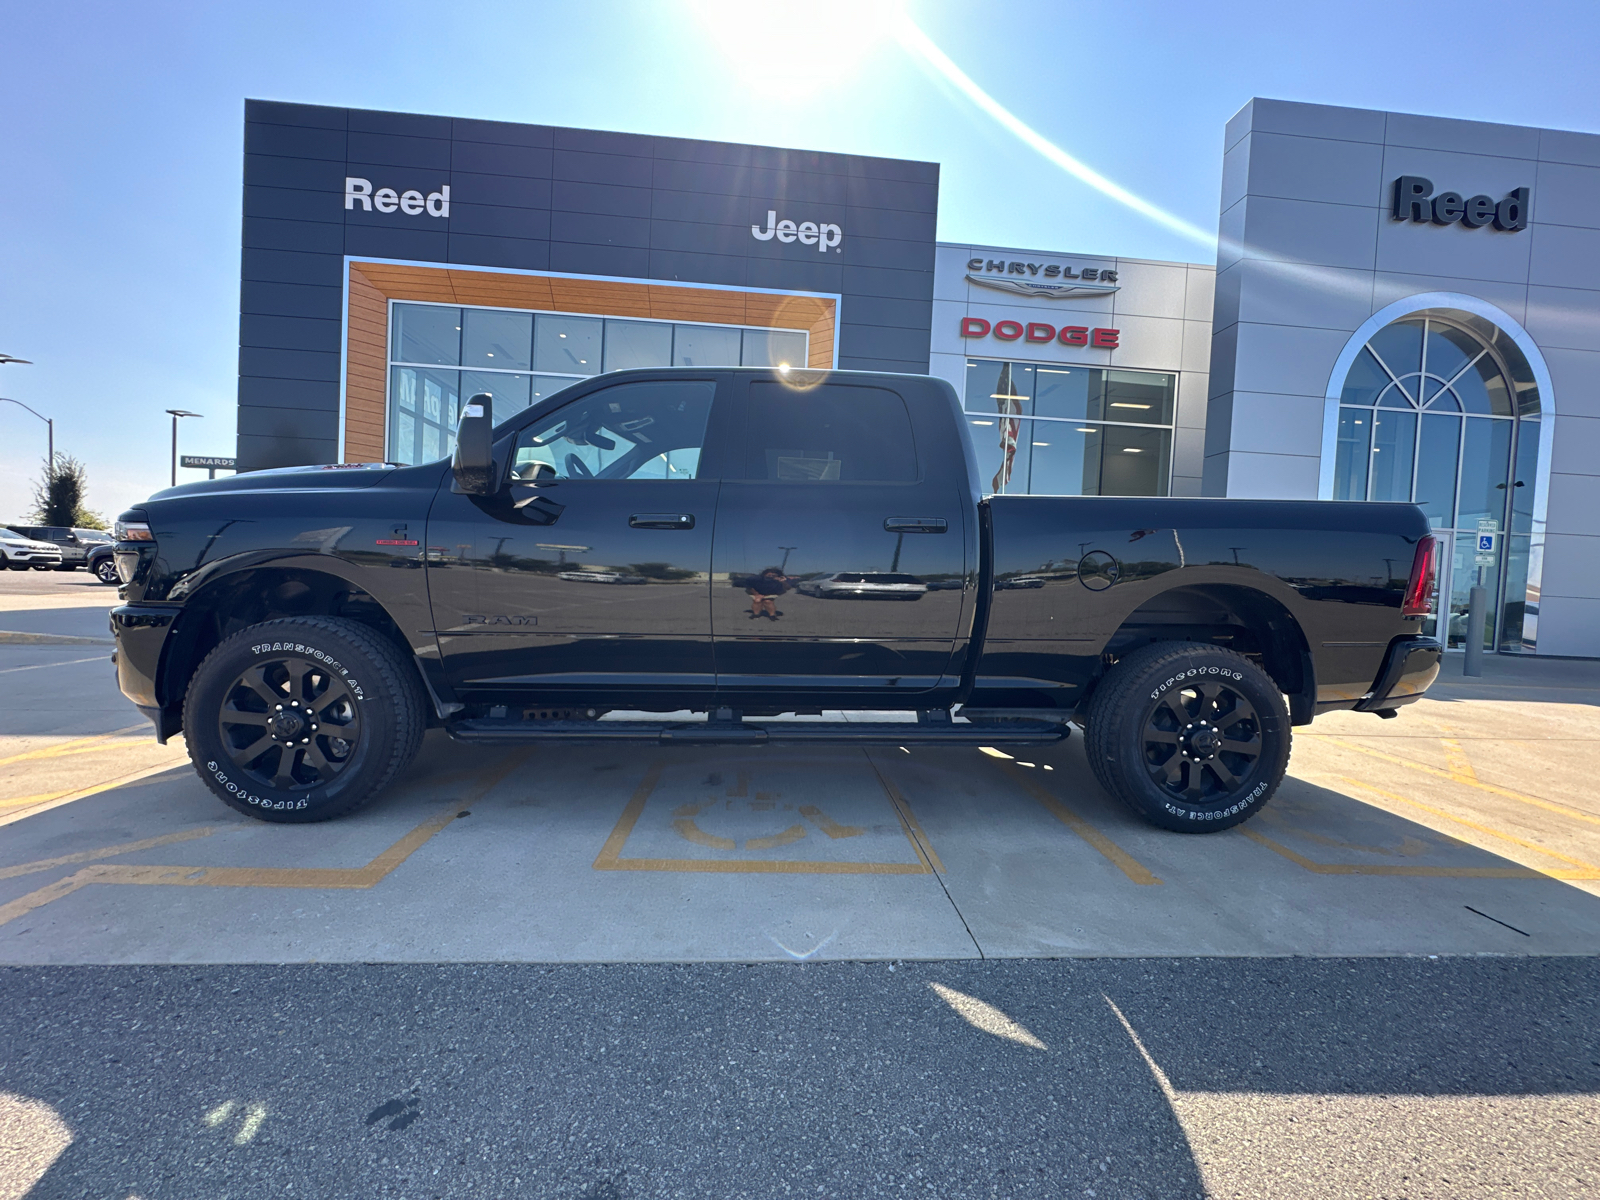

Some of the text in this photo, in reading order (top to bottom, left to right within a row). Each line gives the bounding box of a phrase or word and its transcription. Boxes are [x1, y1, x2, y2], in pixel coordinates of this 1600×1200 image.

[345, 177, 450, 218] Reed
[1393, 175, 1530, 232] Reed
[751, 210, 842, 253] Jeep
[967, 258, 1119, 282] CHRYSLER
[961, 317, 1120, 348] DODGE
[184, 457, 235, 466] MENARDS
[462, 614, 538, 626] RAM
[251, 642, 349, 676] TRANSFORCE
[1189, 781, 1268, 820] TRANSFORCE
